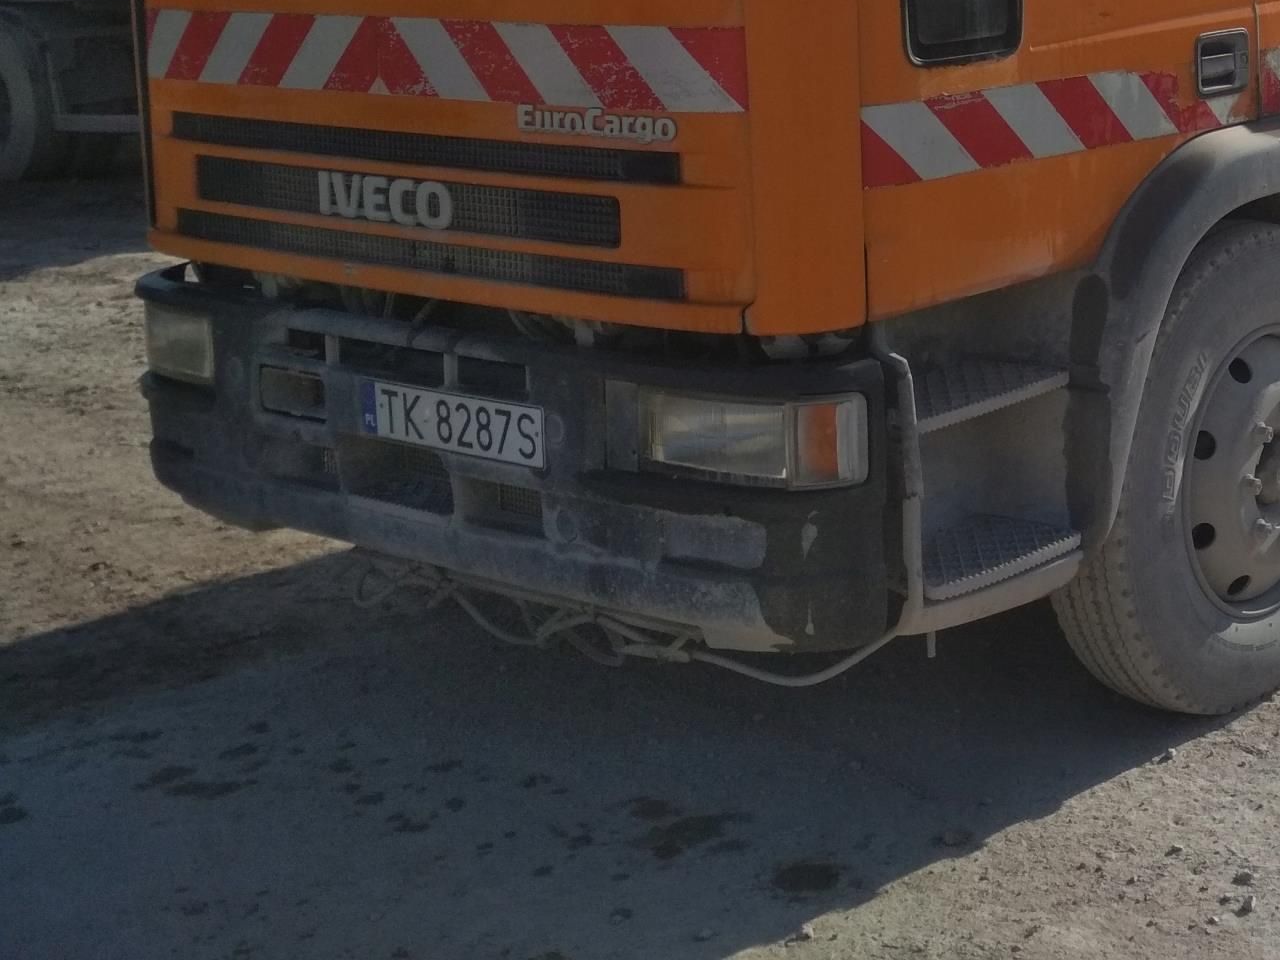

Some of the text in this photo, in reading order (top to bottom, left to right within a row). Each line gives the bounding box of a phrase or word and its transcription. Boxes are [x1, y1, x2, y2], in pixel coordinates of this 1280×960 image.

[516, 104, 677, 142] EuroCargo
[317, 170, 453, 229] IVECO
[364, 413, 376, 427] PL
[380, 389, 537, 460] TK 8287S
